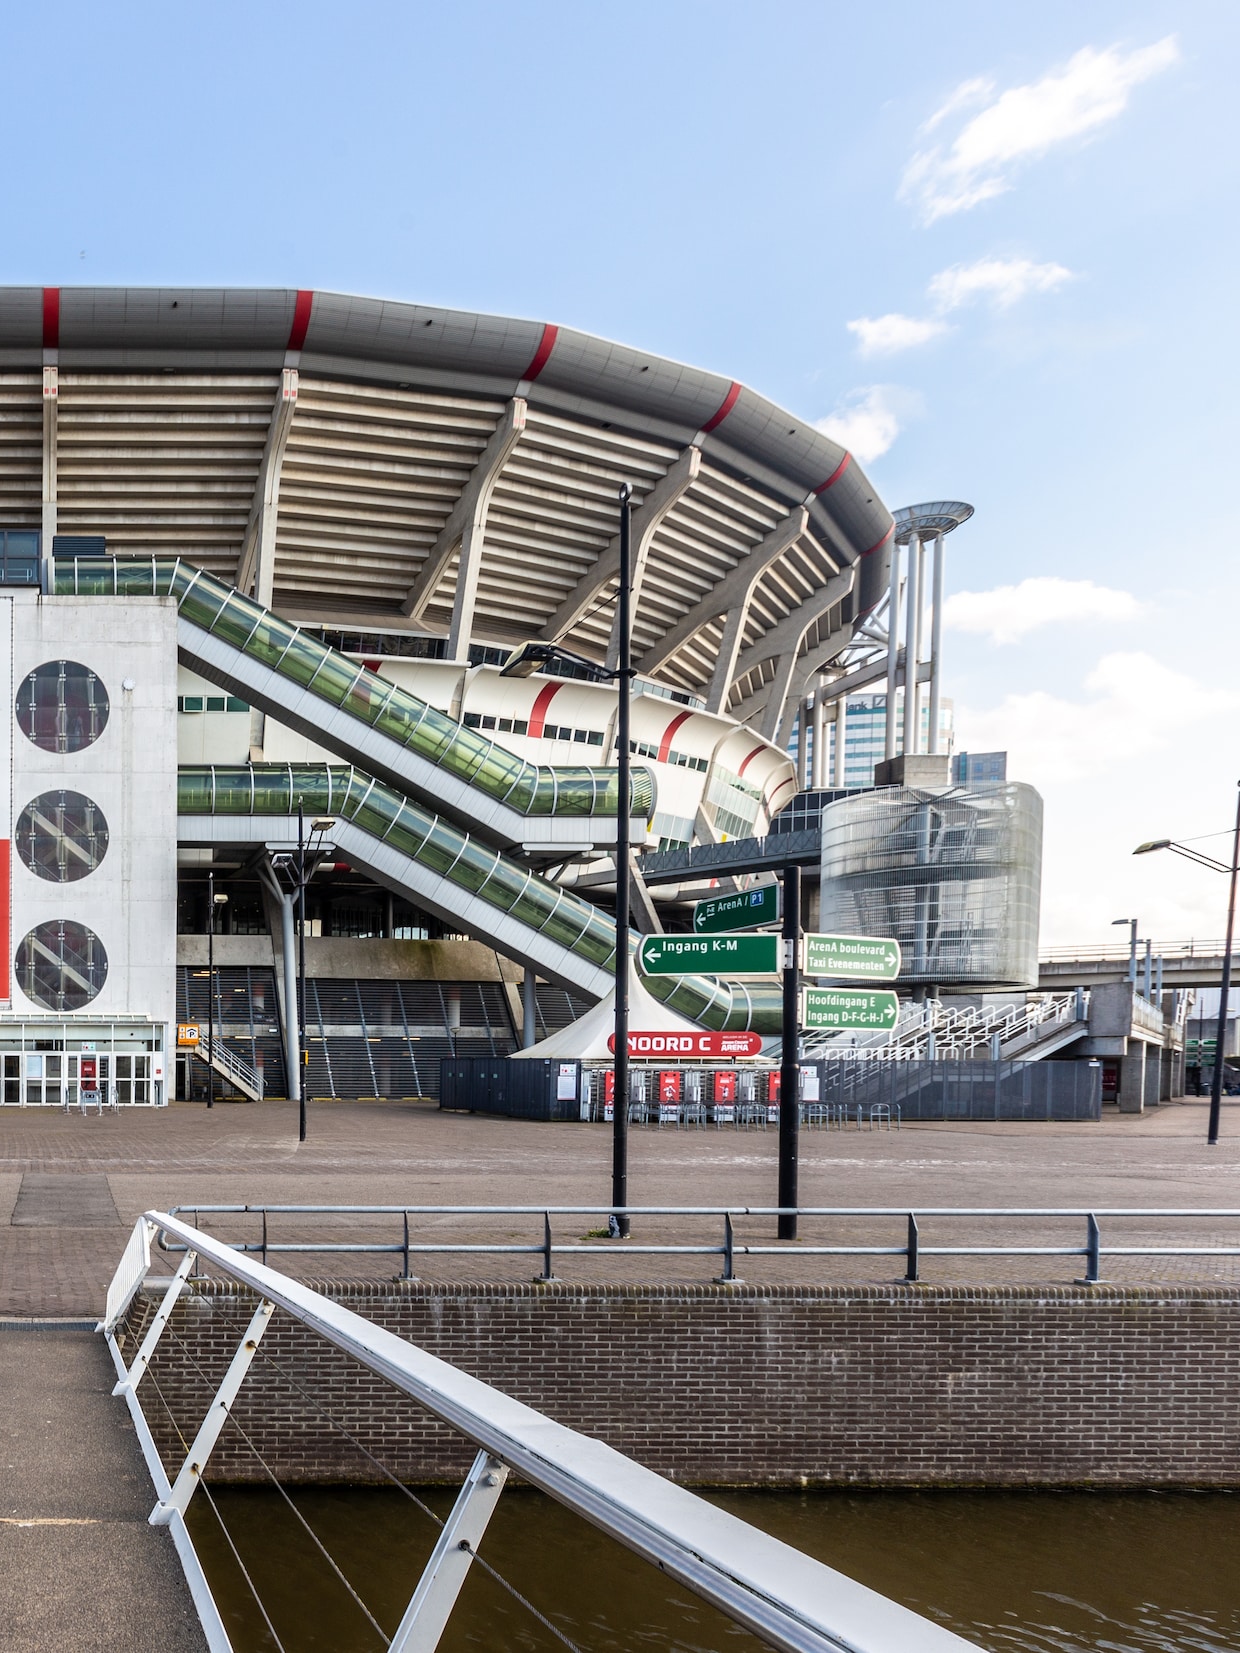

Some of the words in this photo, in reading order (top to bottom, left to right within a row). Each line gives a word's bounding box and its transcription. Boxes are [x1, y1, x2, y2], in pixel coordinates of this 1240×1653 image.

[846, 701, 867, 710] ank
[717, 897, 743, 912] ArenA
[662, 941, 708, 954] Ingang
[712, 940, 738, 951] K-M
[808, 940, 837, 952] ArenA
[840, 942, 885, 955] boulevard
[808, 956, 826, 967] Taxi
[828, 958, 884, 971] Evenementen
[808, 994, 868, 1009] Hoofdingang
[870, 996, 876, 1007] E
[807, 1010, 839, 1024] Ingang
[841, 1011, 884, 1023] D-F-G-H-J
[698, 1037, 711, 1051] C
